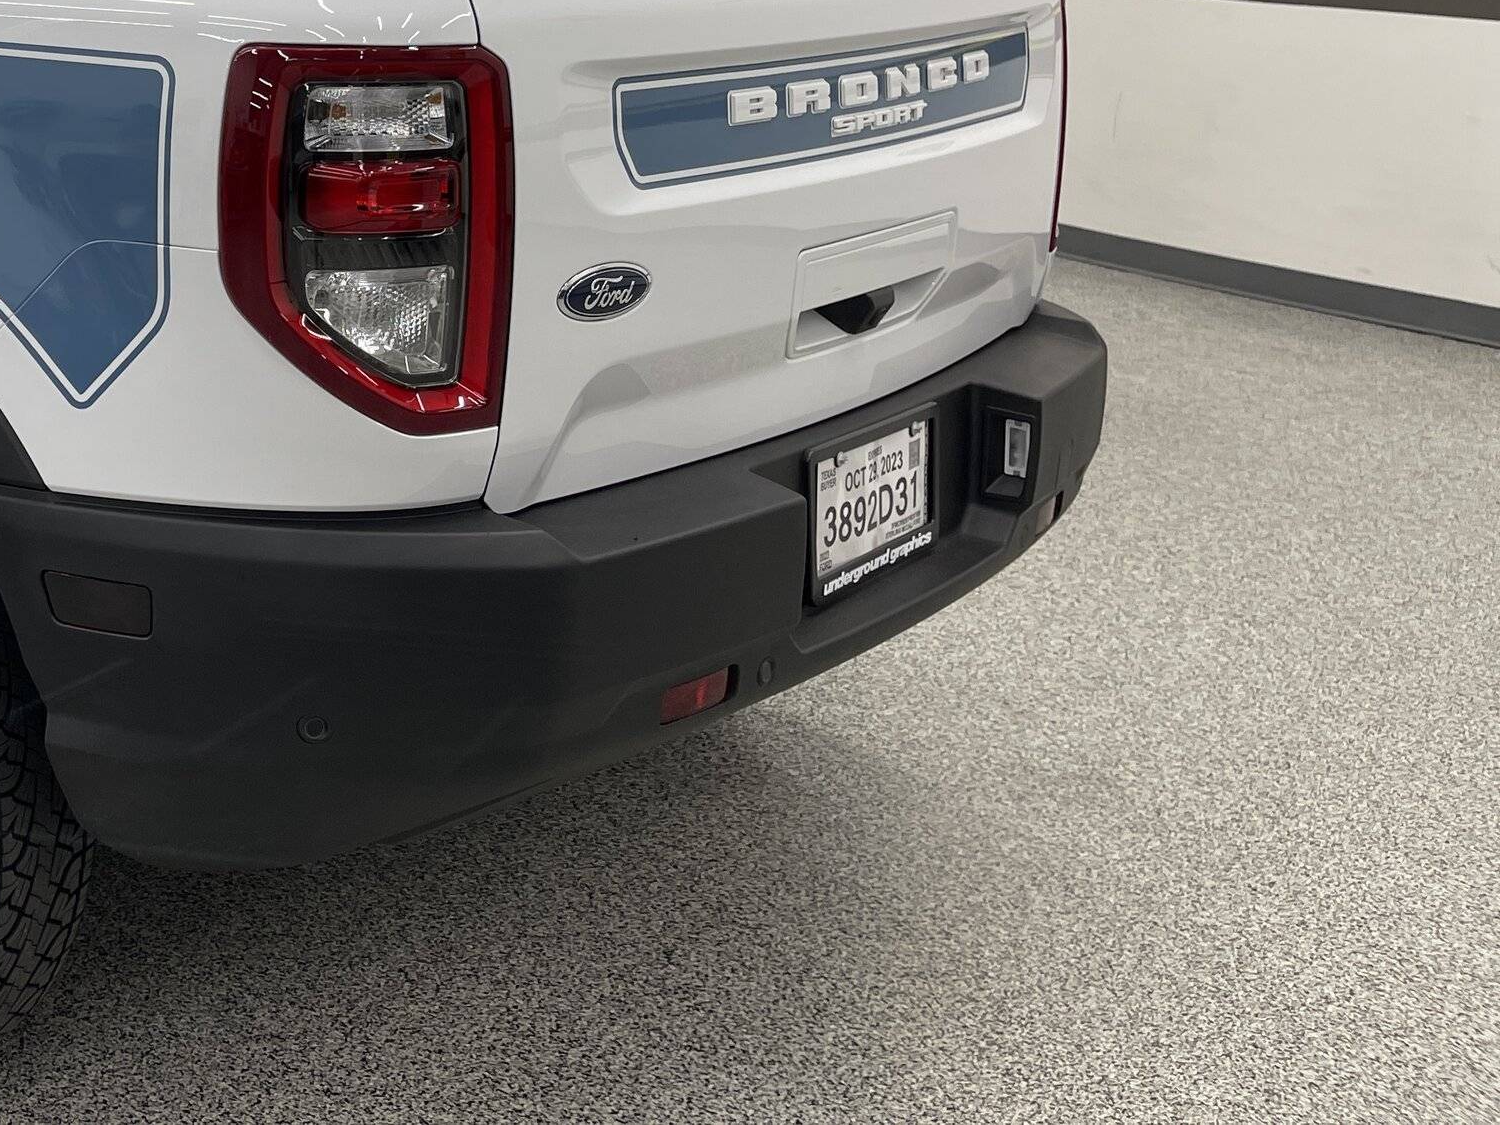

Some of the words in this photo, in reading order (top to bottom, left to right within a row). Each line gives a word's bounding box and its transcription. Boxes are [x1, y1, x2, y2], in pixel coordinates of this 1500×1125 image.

[727, 49, 990, 126] BRONCO
[831, 99, 927, 137] SPORT
[584, 275, 635, 310] Ford
[845, 467, 866, 491] OCT
[881, 450, 903, 476] 2023
[823, 470, 918, 548] 3892D31
[823, 548, 891, 596] underground
[890, 531, 932, 564] graphics
